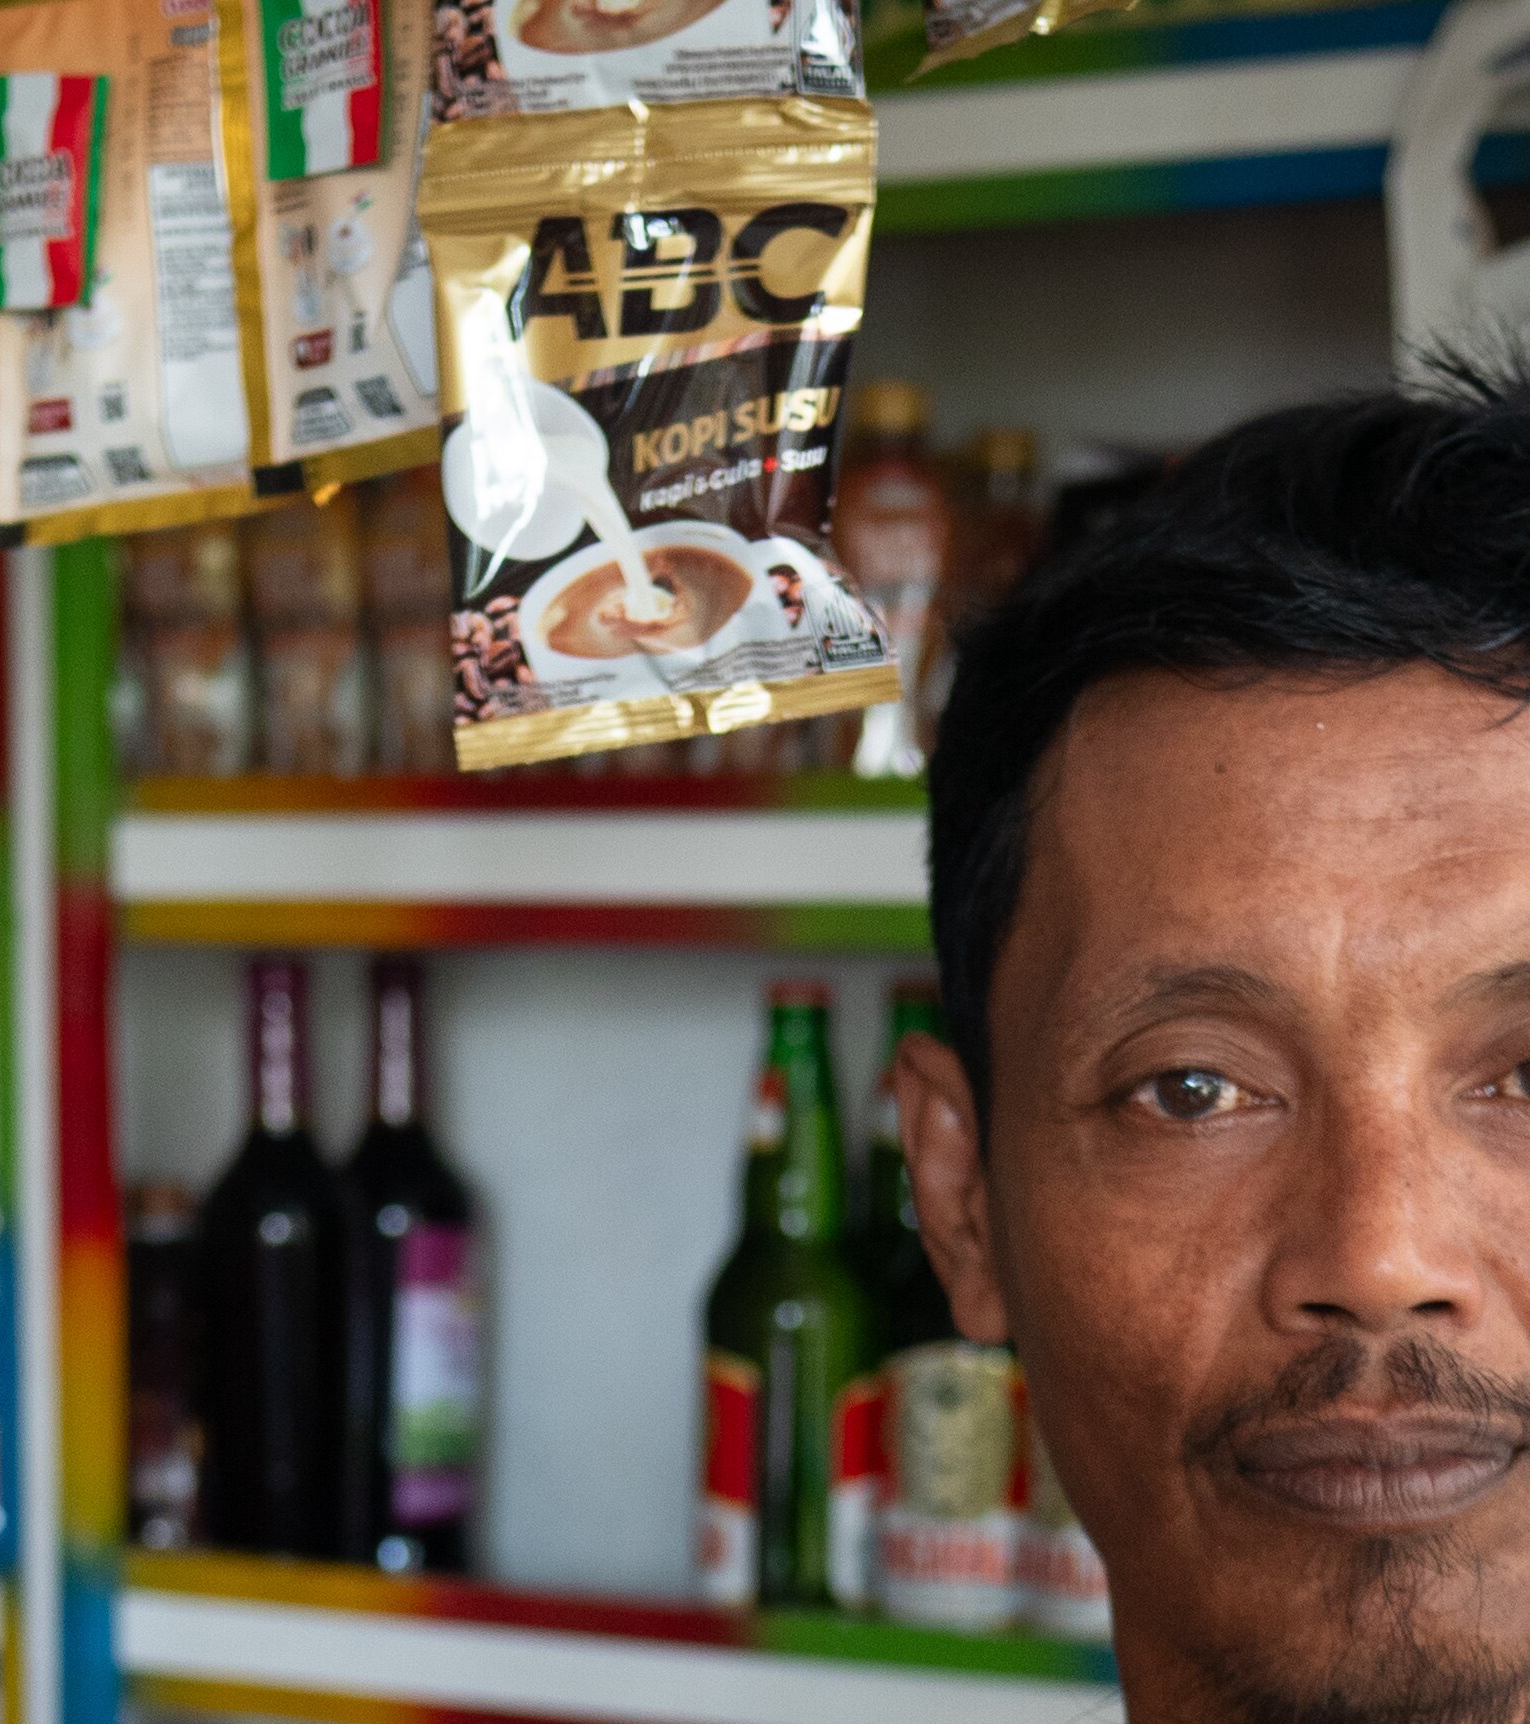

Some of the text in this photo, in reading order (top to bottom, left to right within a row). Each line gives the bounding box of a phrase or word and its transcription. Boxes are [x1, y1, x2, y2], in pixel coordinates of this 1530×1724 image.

[506, 202, 850, 341] ABC
[632, 386, 841, 474] KOPI SUSU
[780, 445, 828, 473] Susu
